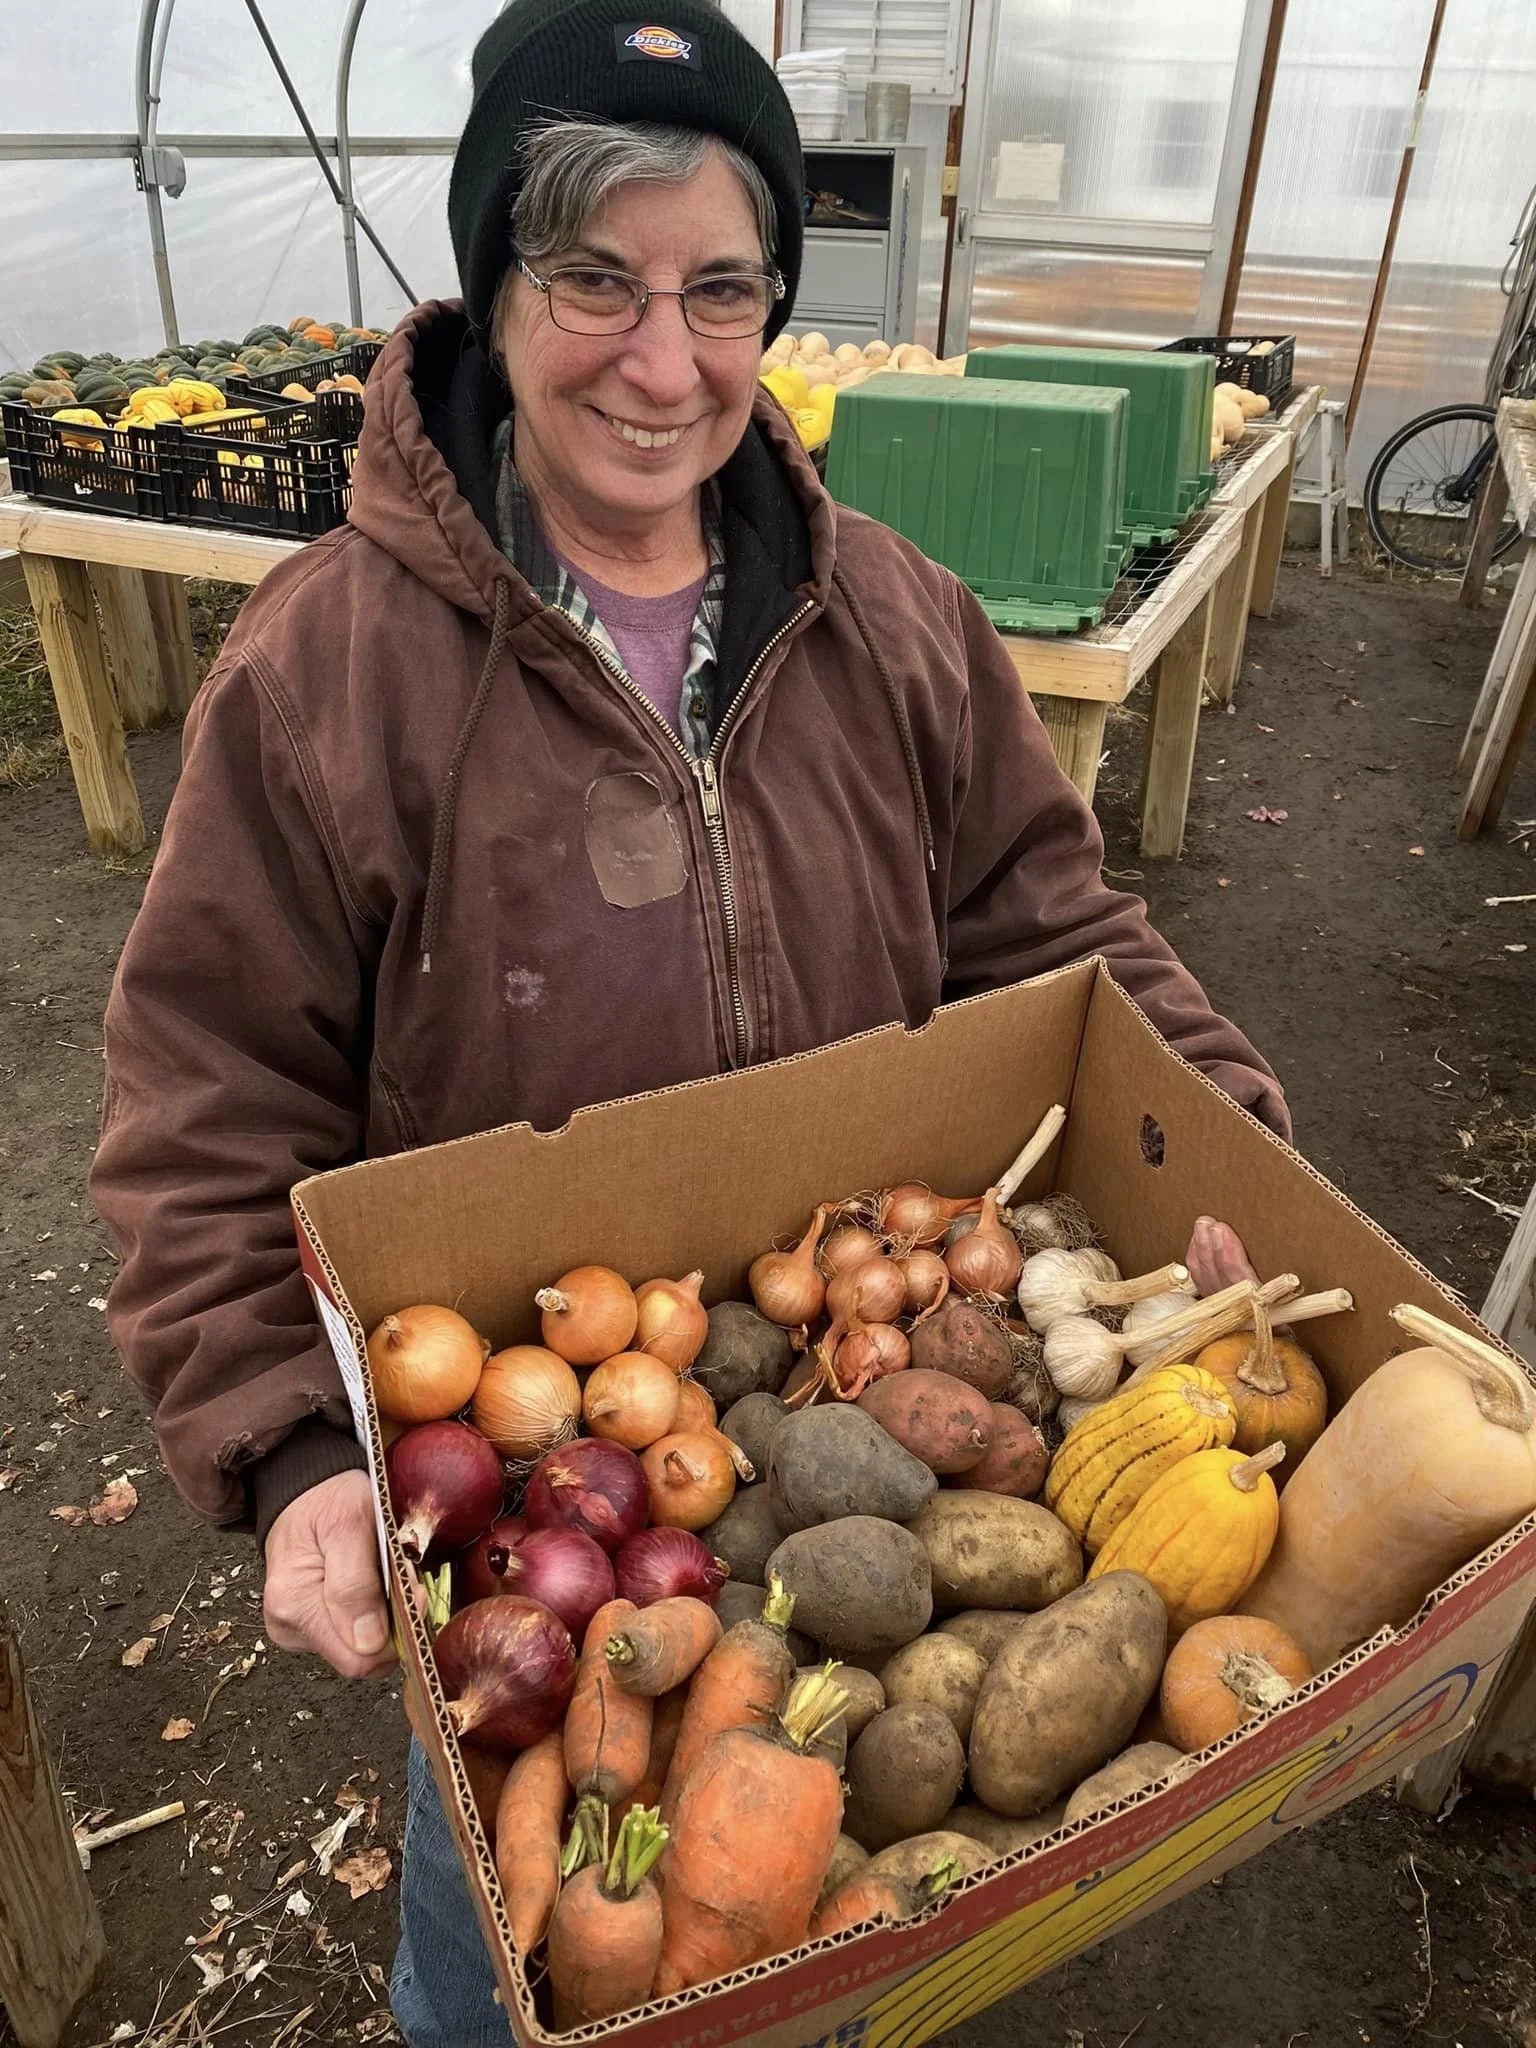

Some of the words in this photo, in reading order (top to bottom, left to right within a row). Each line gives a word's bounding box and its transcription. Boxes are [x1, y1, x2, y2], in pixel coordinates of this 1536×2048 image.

[633, 36, 686, 49] Dickies
[1016, 1812, 1171, 1900] BANANAS
[789, 1919, 964, 2008] PREMIUM
